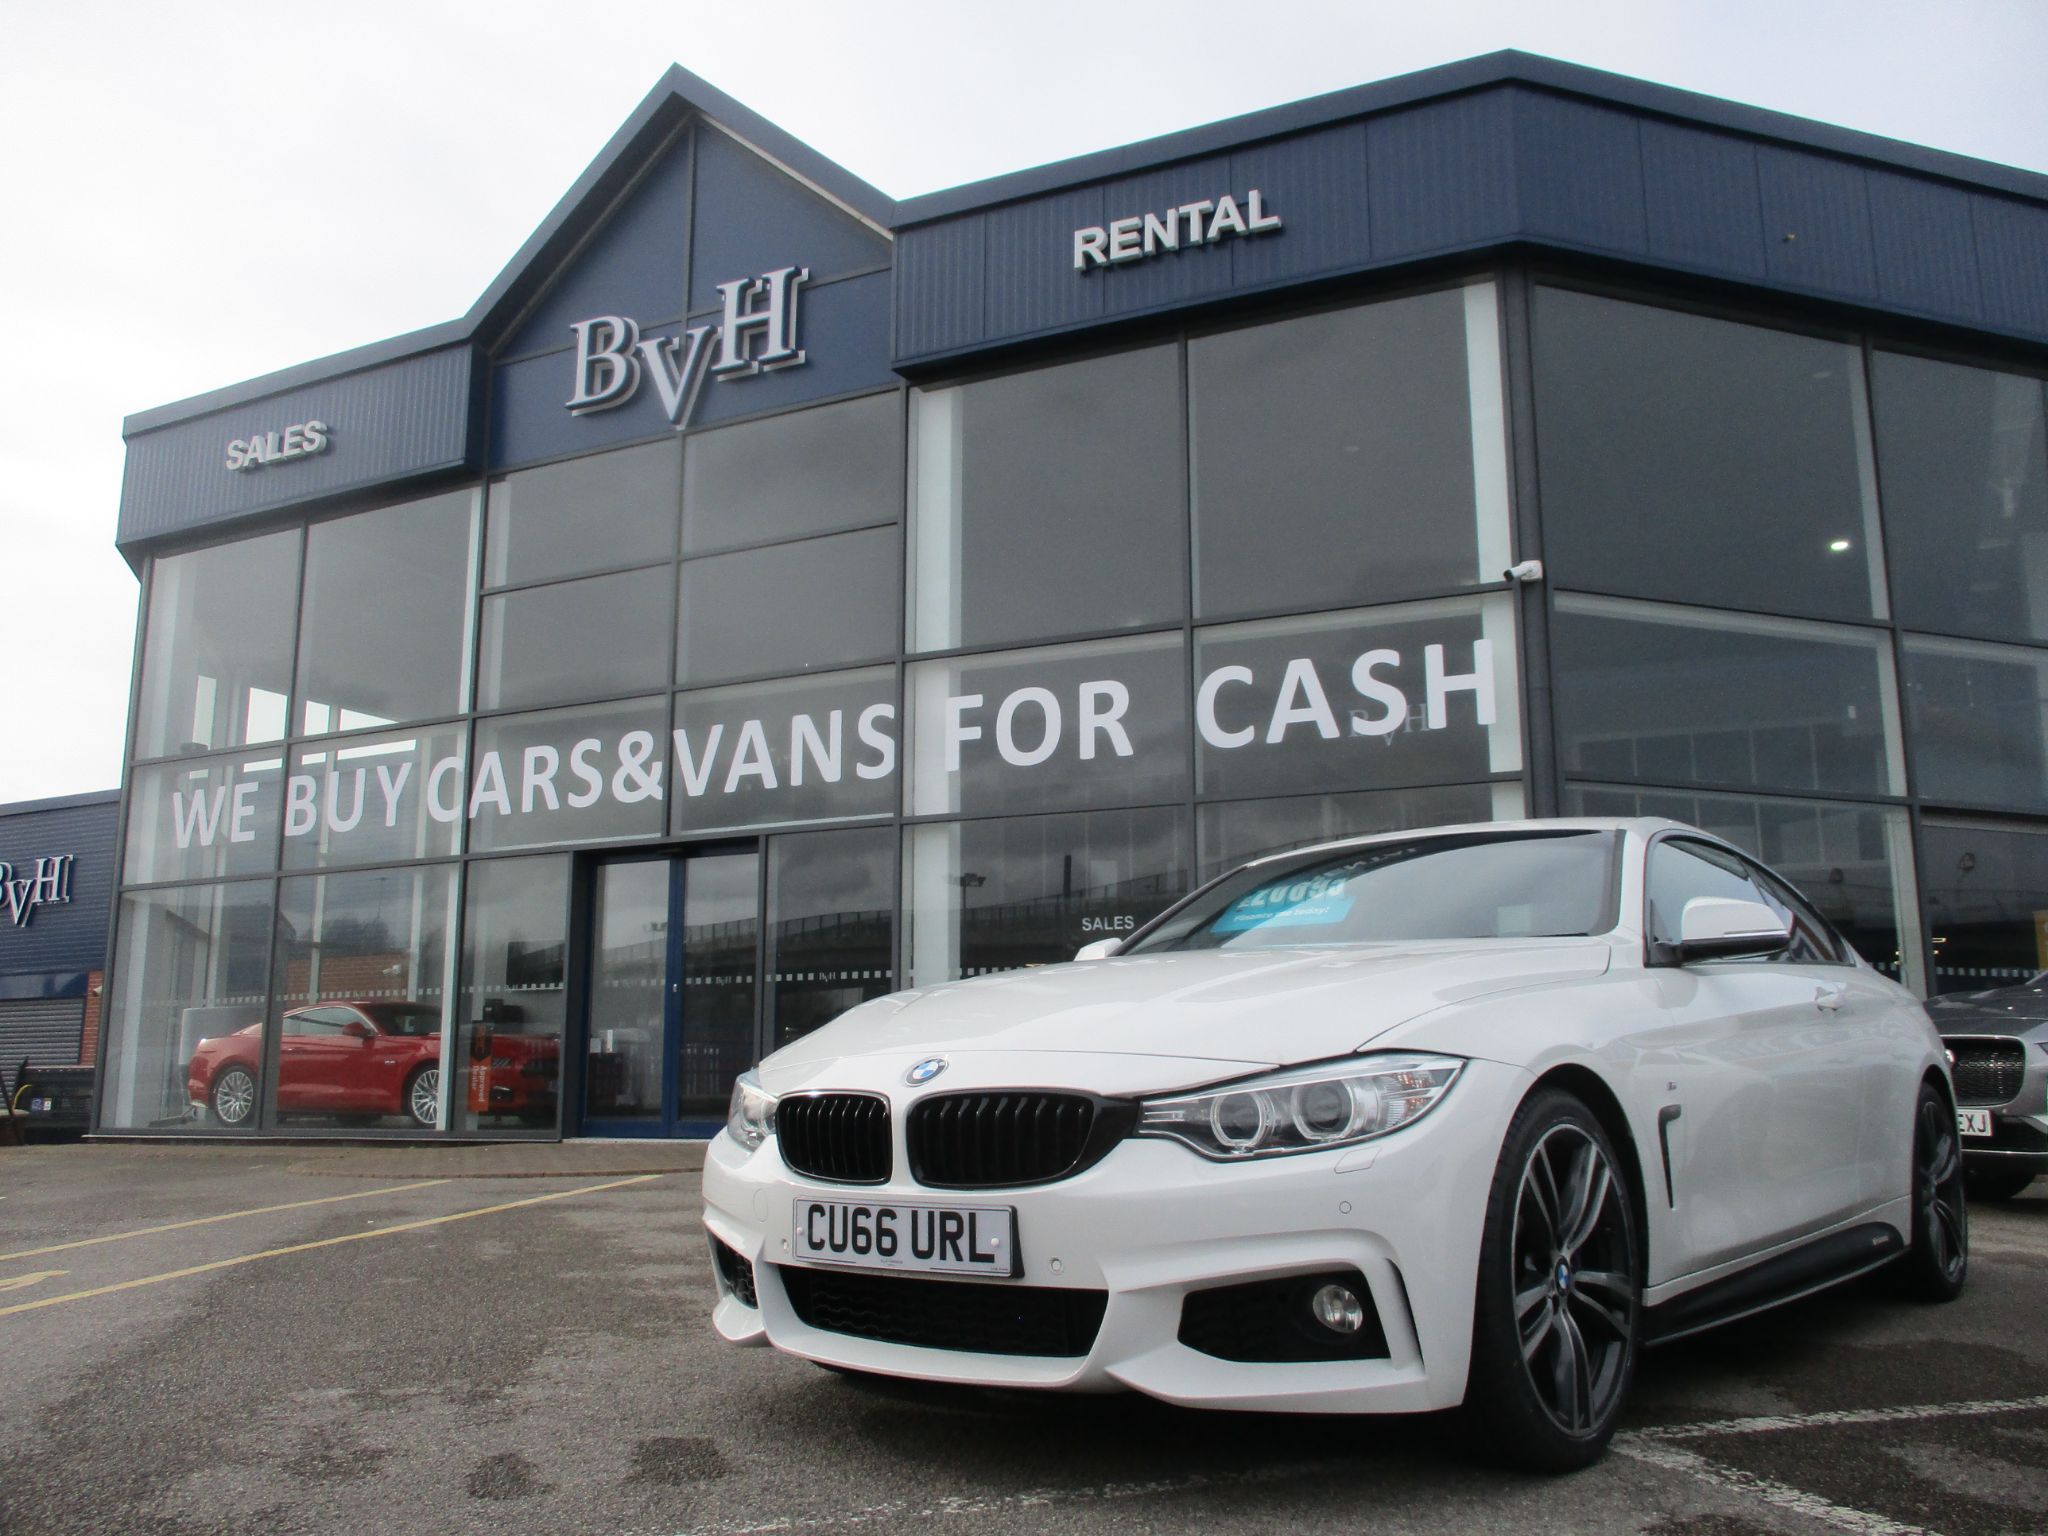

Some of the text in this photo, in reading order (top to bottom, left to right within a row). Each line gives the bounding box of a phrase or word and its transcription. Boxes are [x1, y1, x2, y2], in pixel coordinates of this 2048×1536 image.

[1073, 189, 1282, 271] RENTAL
[225, 420, 328, 472] SALES
[172, 781, 260, 849] WE
[284, 762, 413, 837] BUY
[944, 679, 1134, 772] FOR
[1196, 638, 1497, 749] CASH
[0, 854, 74, 928] VH
[1081, 915, 1135, 932] SALES
[807, 1203, 996, 1264] CU66 URL
